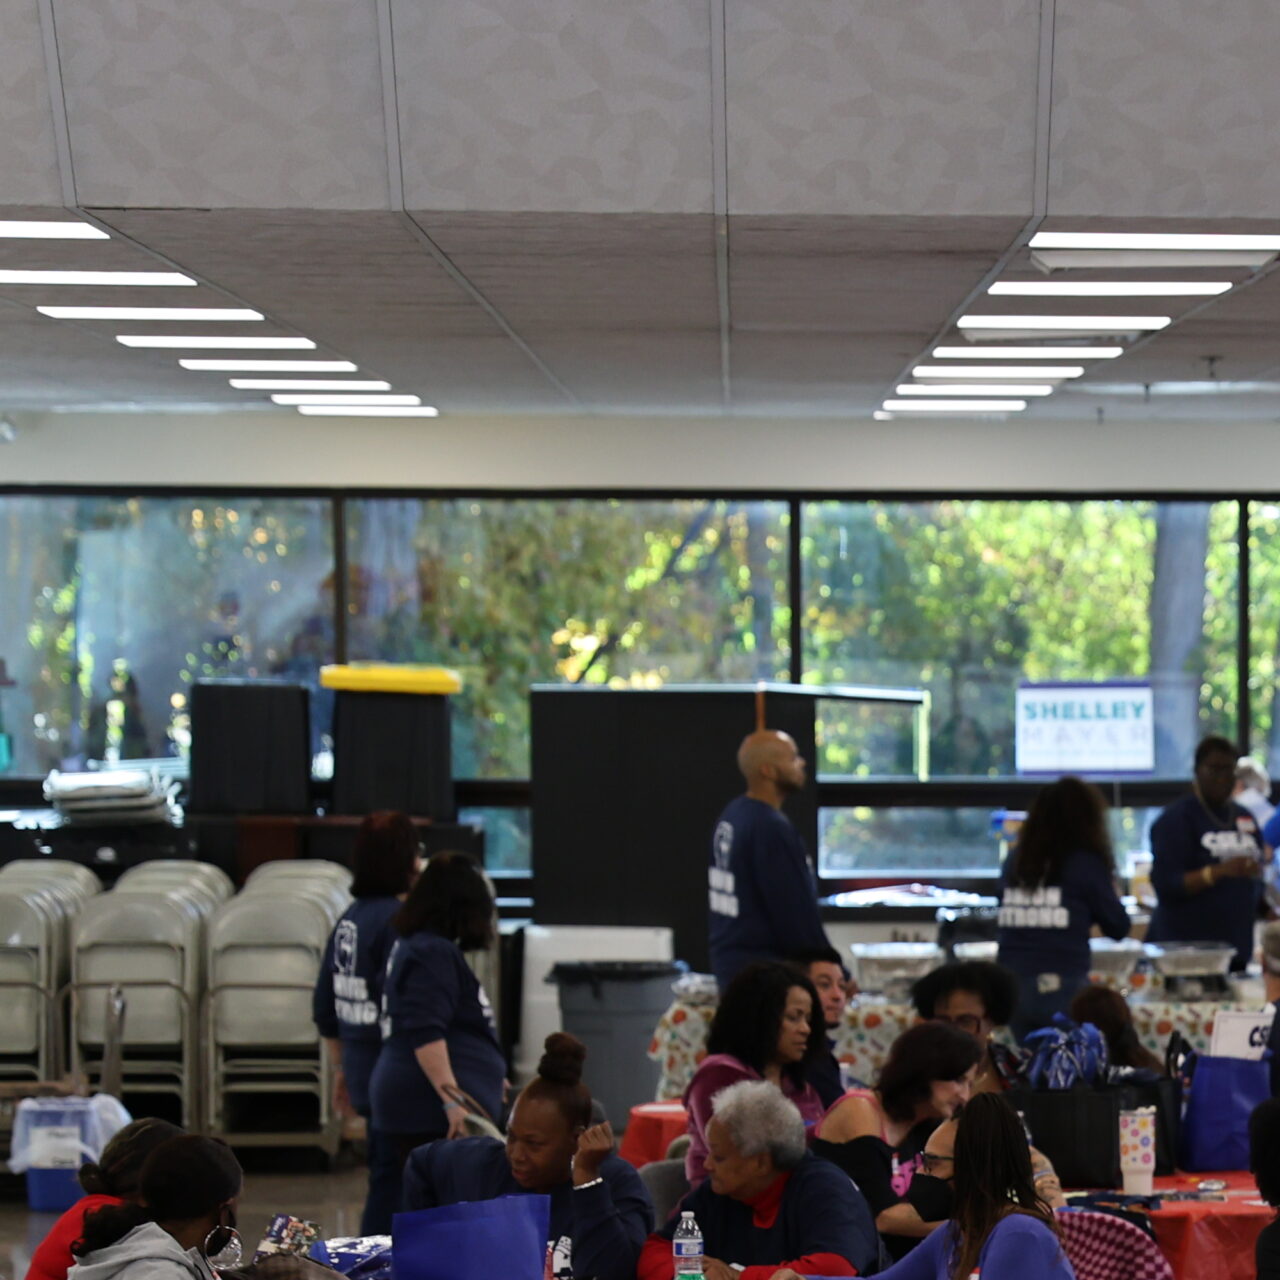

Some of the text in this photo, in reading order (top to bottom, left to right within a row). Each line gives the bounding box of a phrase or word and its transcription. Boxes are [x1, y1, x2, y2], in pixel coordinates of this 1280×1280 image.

[1024, 701, 1145, 720] SHELLEY
[1023, 726, 1149, 745] MAYER
[1249, 1025, 1271, 1047] CS
